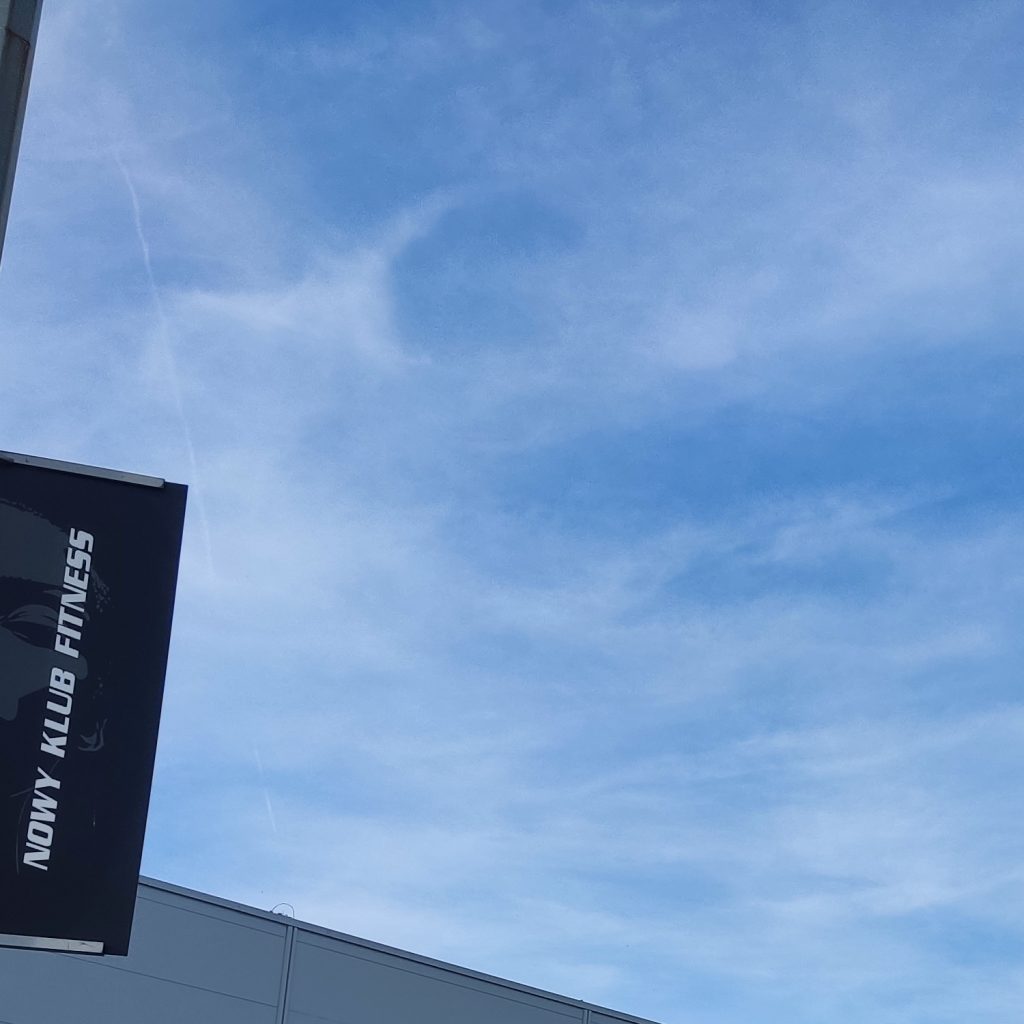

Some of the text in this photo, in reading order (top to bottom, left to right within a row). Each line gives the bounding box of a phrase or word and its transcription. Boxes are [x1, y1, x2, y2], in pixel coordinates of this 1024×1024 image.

[23, 527, 94, 871] NOWY KLUB FITNESS
